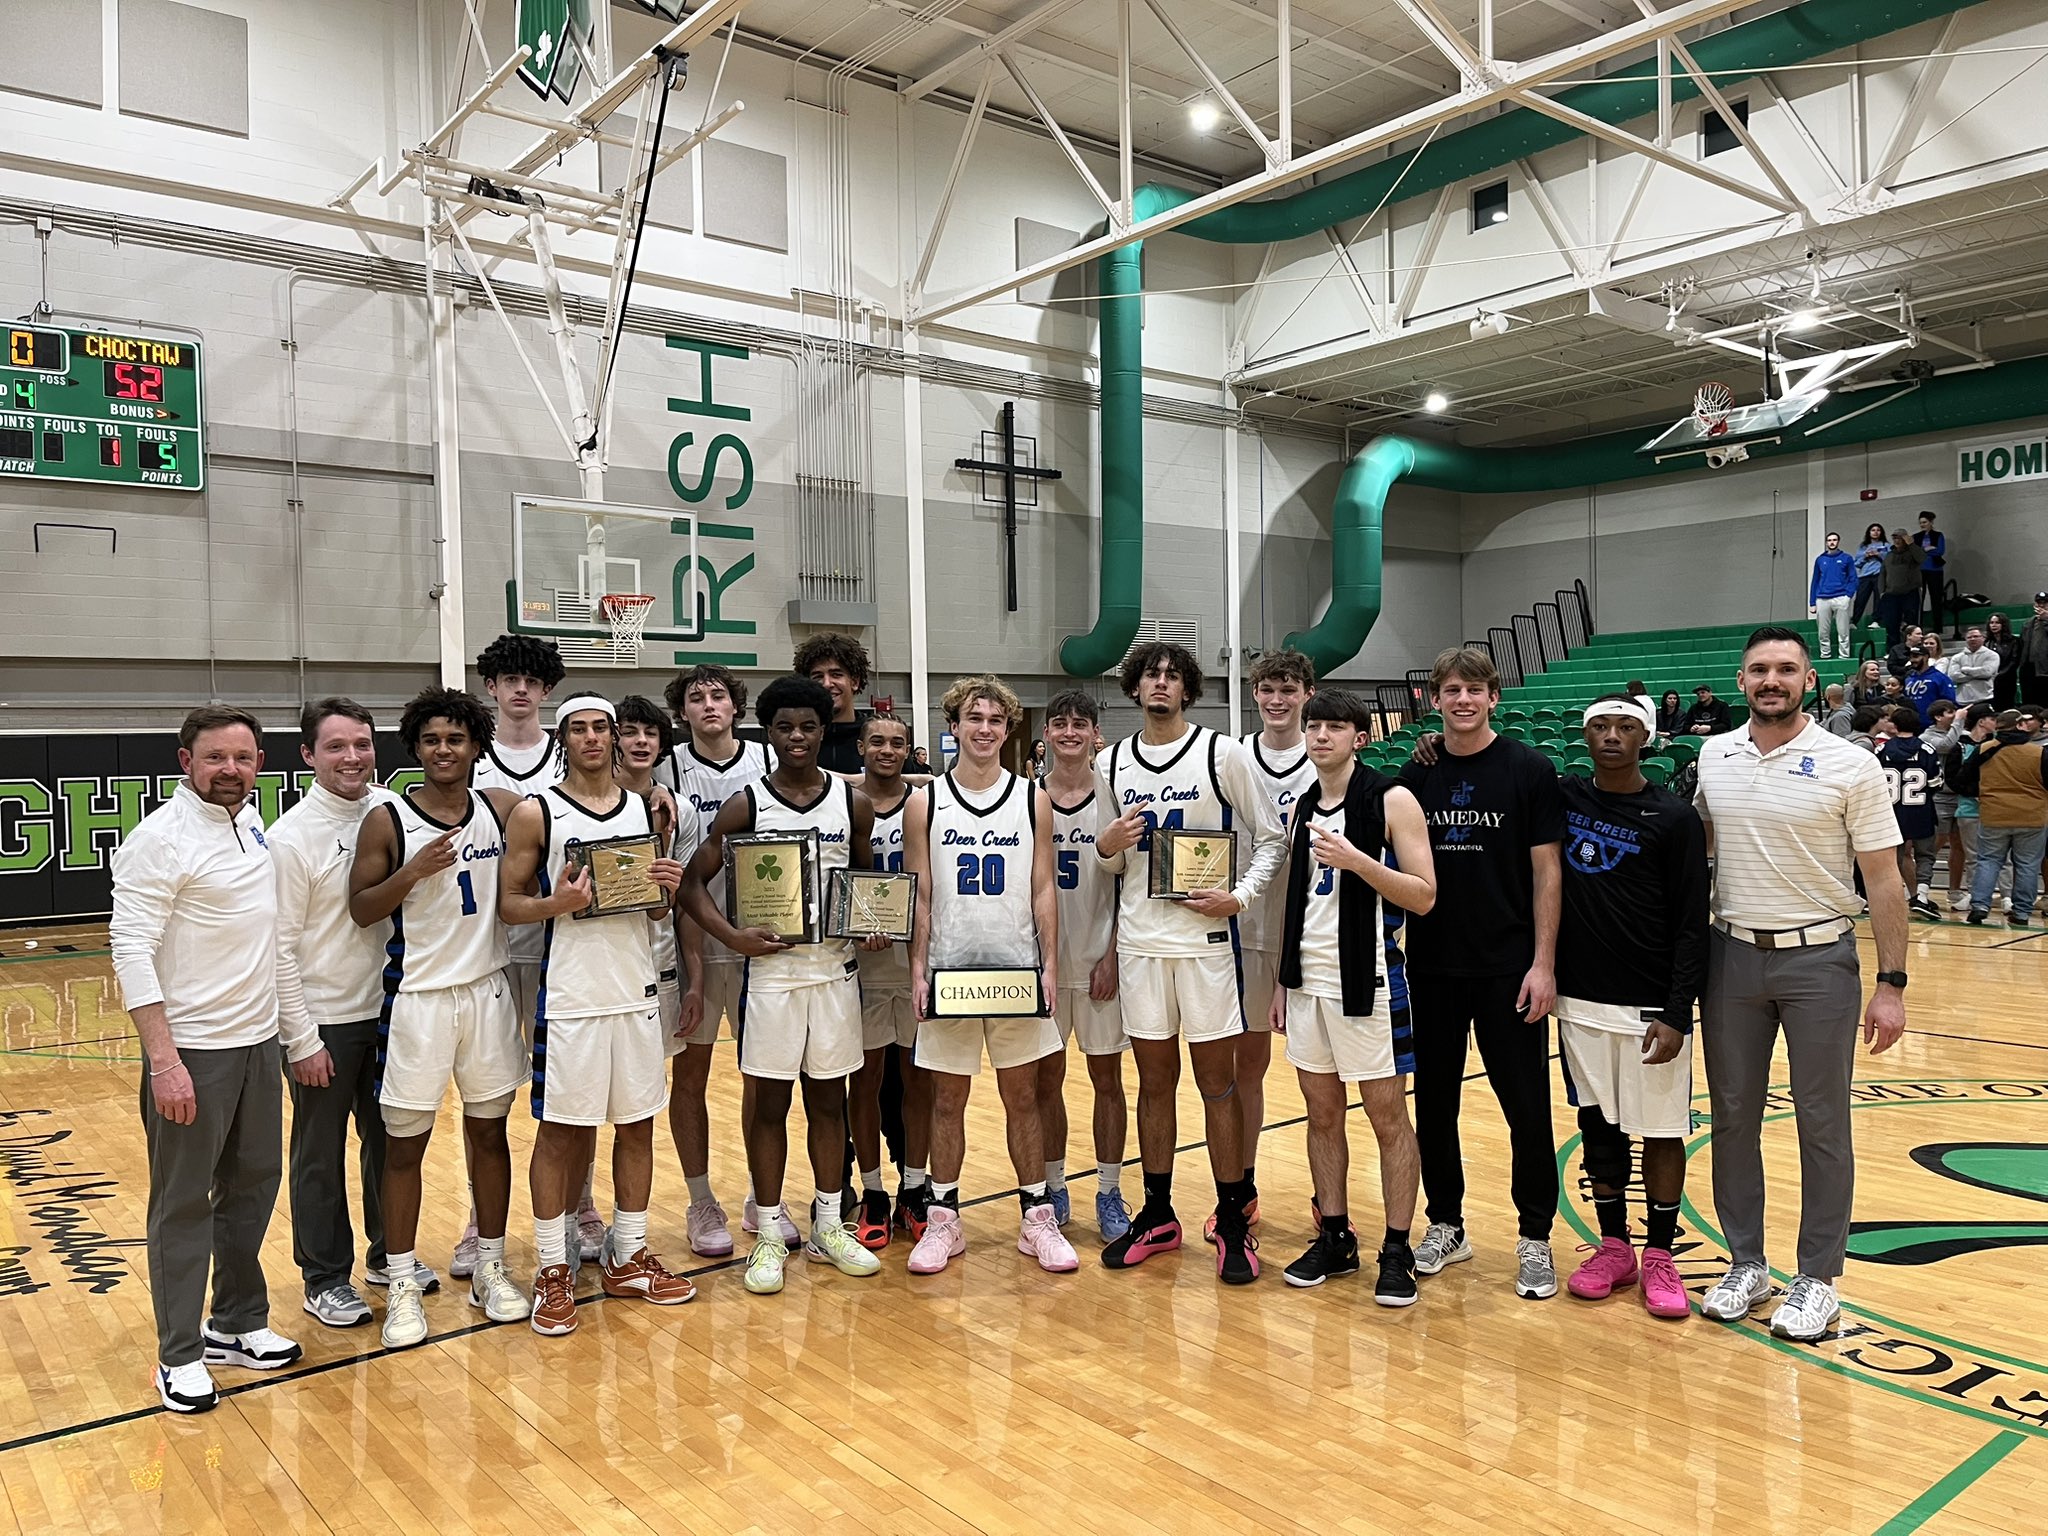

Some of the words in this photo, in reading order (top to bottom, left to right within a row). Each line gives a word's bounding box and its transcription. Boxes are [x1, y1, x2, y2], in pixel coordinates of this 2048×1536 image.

[11, 331, 34, 366] 0
[85, 335, 180, 366] CHOCTAW
[39, 374, 66, 386] POSS
[114, 363, 162, 401] 52
[16, 382, 34, 408] 4
[110, 403, 154, 419] BONUS
[44, 418, 87, 434] FOULS
[96, 423, 122, 437] TOL
[136, 427, 177, 442] FOULS
[112, 439, 120, 466] 1
[158, 443, 176, 470] 5
[1961, 443, 2048, 483] HOM
[141, 471, 183, 484] POINTS
[665, 333, 758, 667] IRISH
[1123, 788, 1156, 806] Deer
[1160, 784, 1200, 802] Creek
[942, 828, 977, 847] Deer
[981, 829, 1020, 847] Creek
[1052, 832, 1066, 844] er
[1593, 820, 1639, 842] CREEK
[462, 841, 500, 862] Creek
[956, 852, 1005, 896] 20
[1057, 850, 1080, 890] 5
[457, 870, 477, 917] 1
[940, 985, 1033, 1000] CHAMPION
